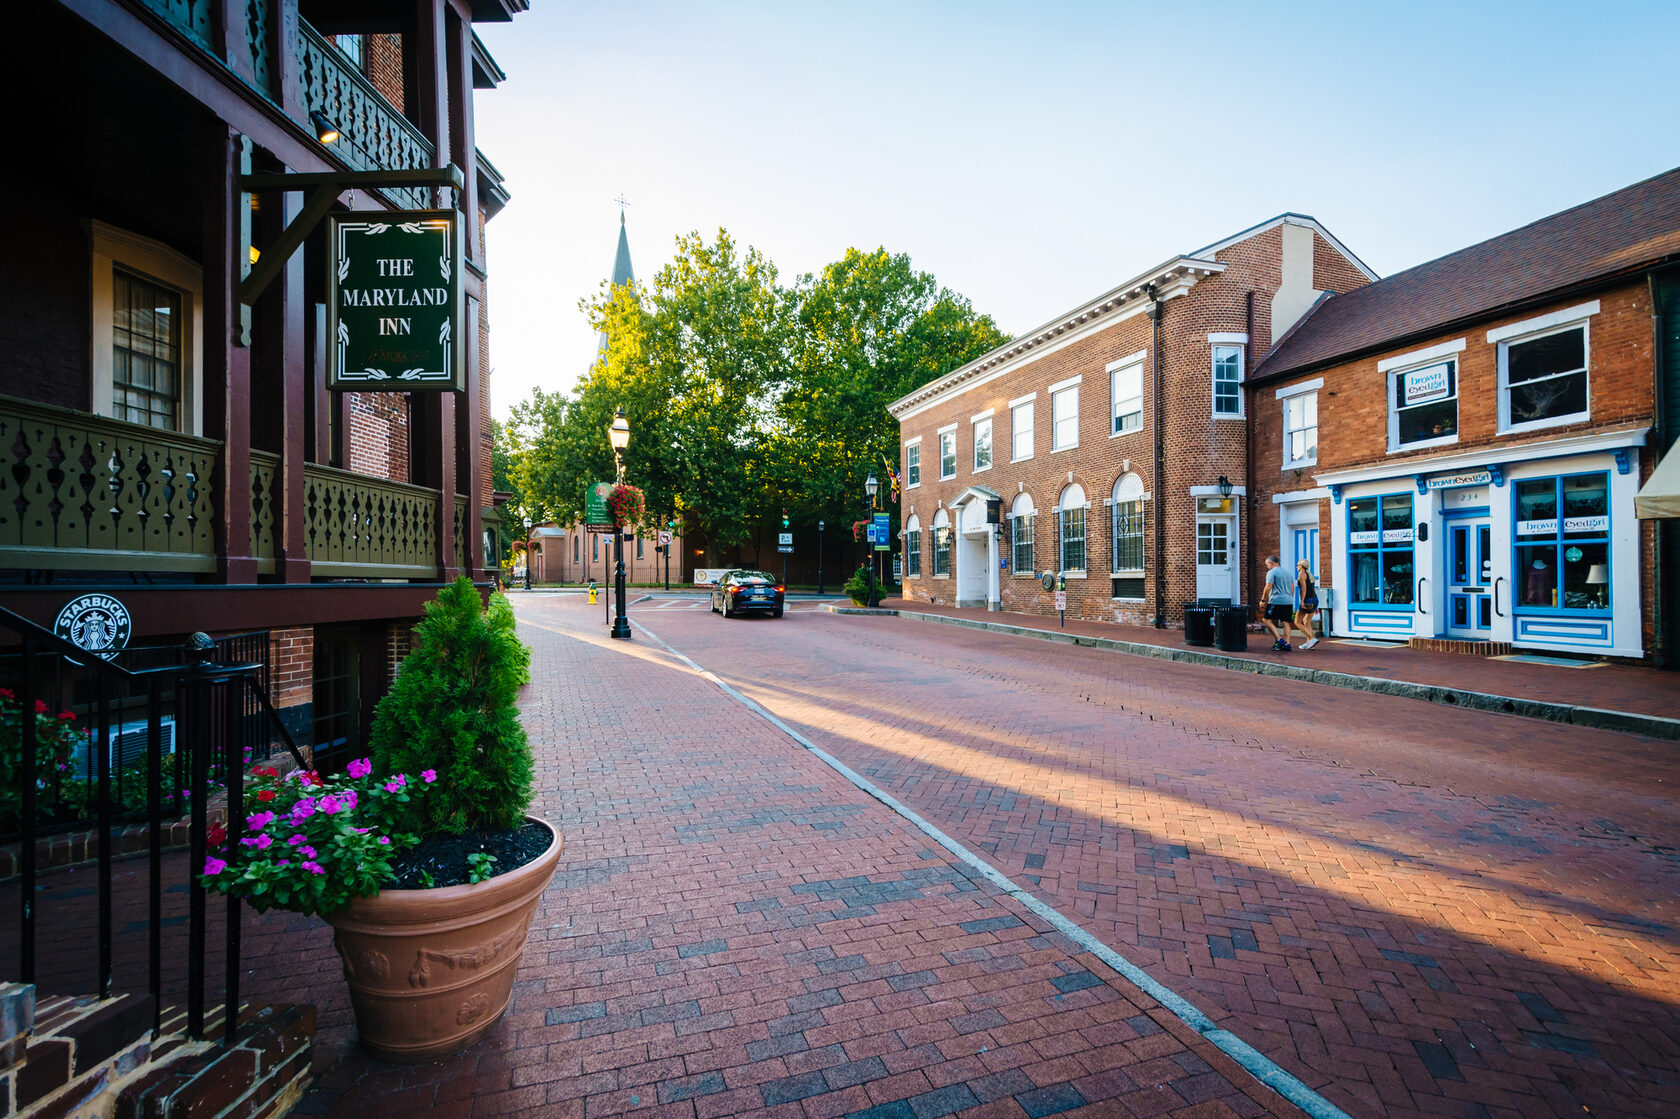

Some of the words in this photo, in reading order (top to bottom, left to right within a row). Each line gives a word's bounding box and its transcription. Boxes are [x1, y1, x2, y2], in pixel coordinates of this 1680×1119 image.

[376, 258, 414, 277] THE
[343, 288, 448, 307] MARYLAND
[378, 317, 412, 336] INN
[1410, 373, 1442, 385] brown
[1460, 493, 1478, 501] 234
[1526, 522, 1557, 530] brown
[59, 596, 128, 628] STARBUCKS
